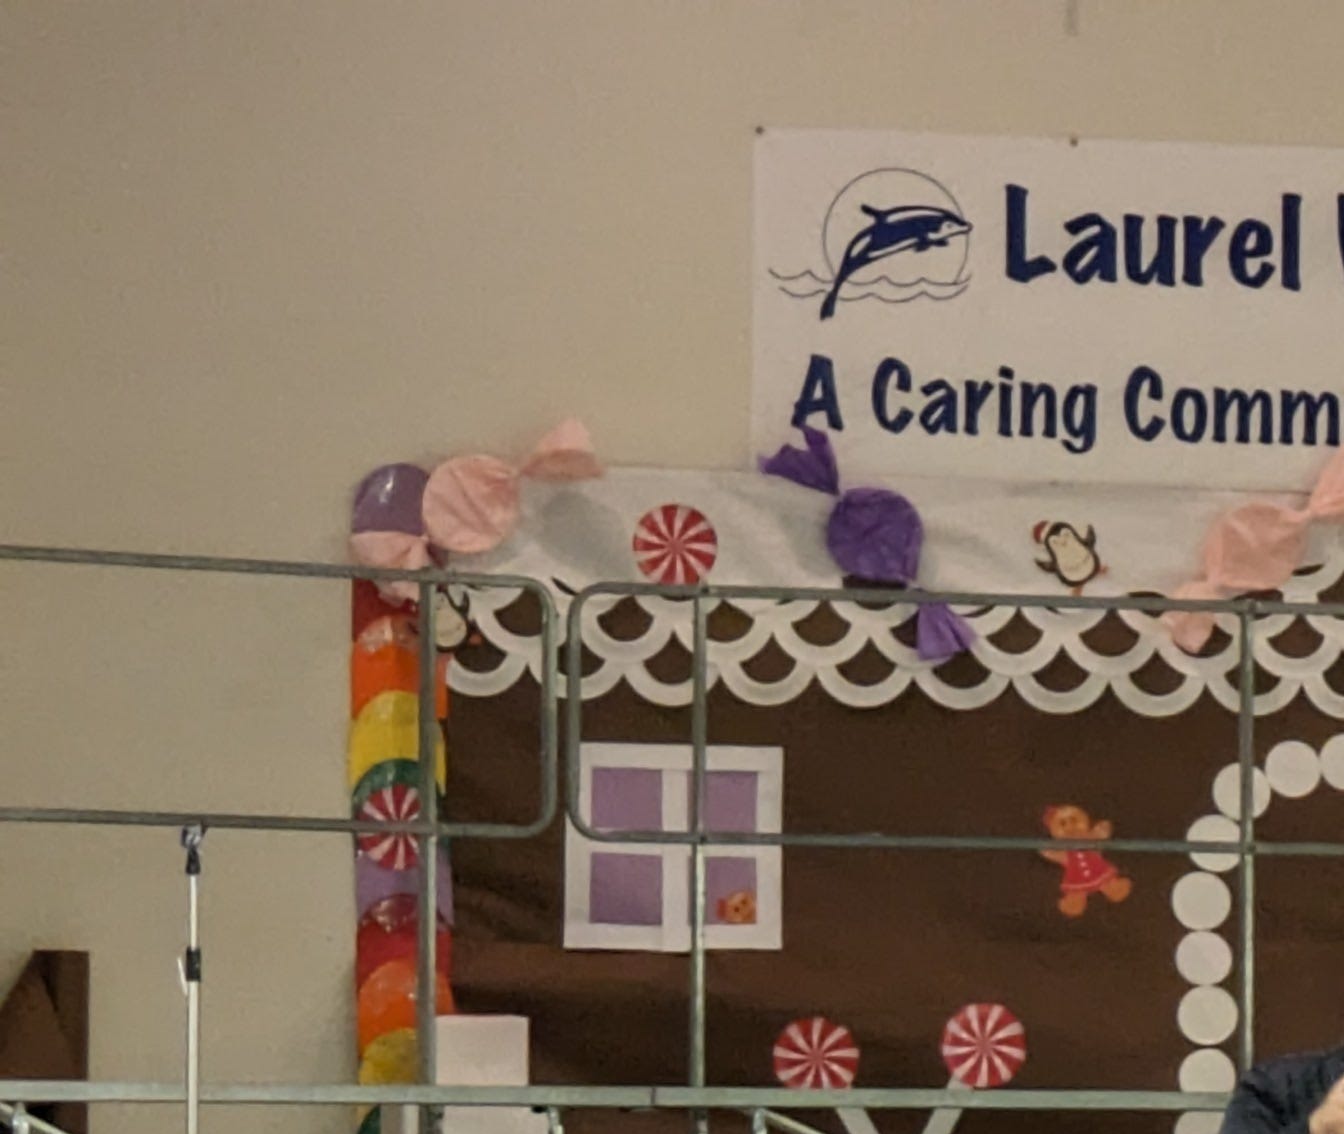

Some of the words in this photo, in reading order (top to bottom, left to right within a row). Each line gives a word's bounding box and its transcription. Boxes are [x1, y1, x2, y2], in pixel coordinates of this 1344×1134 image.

[1008, 186, 1300, 290] Laurel
[795, 358, 841, 428] A
[874, 359, 1096, 447] Caring
